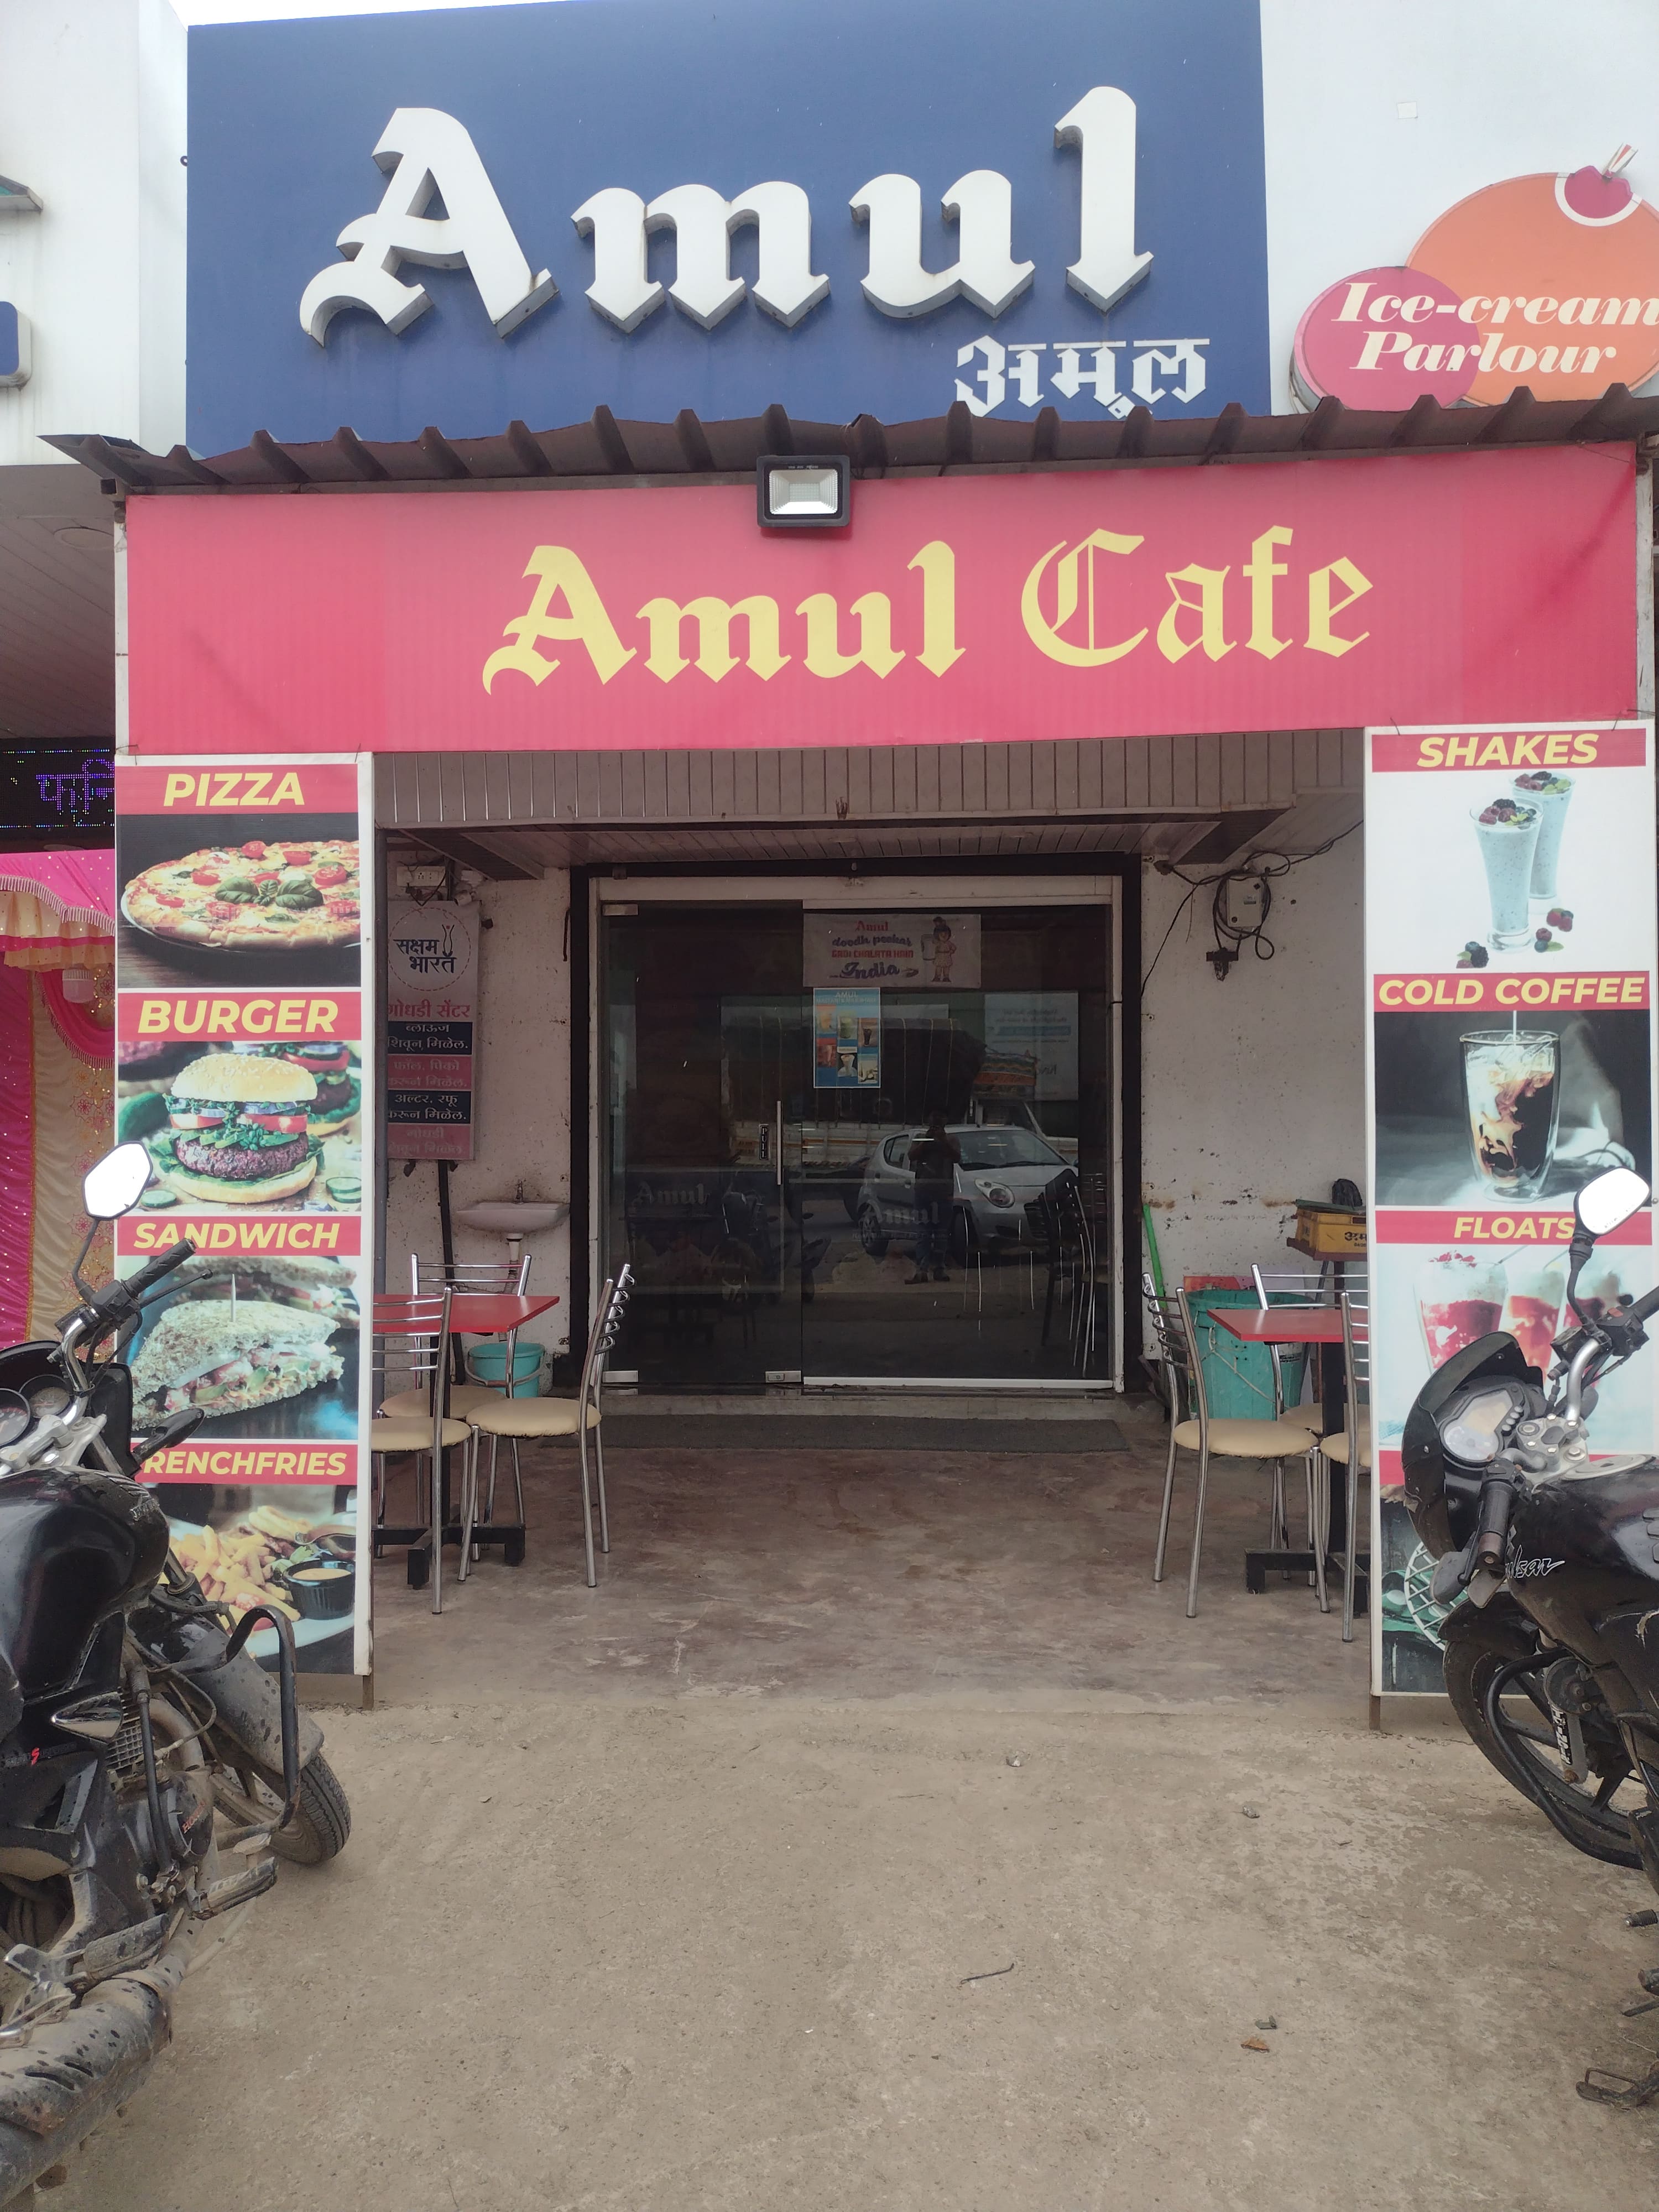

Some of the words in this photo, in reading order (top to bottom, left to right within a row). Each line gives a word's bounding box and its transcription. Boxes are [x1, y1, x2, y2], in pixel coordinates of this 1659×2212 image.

[299, 86, 1154, 348] Amul
[1331, 282, 1659, 326] Ice-cream
[1348, 330, 1616, 373] Parlour
[954, 335, 1210, 420] अमूल
[482, 540, 967, 696] Amul
[1021, 525, 1374, 667] Cafe
[1416, 733, 1600, 768] SHAKES
[163, 772, 306, 807] PIZZA
[855, 920, 889, 932] Amul
[393, 938, 440, 955] सक्षम
[832, 935, 870, 947] doodh
[409, 956, 457, 974] भारत
[840, 961, 900, 979] India
[1379, 979, 1484, 1006] COLD
[1495, 976, 1646, 1005] COFFEE
[137, 999, 338, 1034] BURGER
[436, 999, 470, 1018] सेंटर
[437, 1094, 459, 1107] रफू
[633, 1180, 709, 1206] Amul
[133, 1223, 340, 1249] SANDWICH
[1453, 1217, 1575, 1239] FLOATS
[143, 1452, 347, 1477] RENCHFRIES
